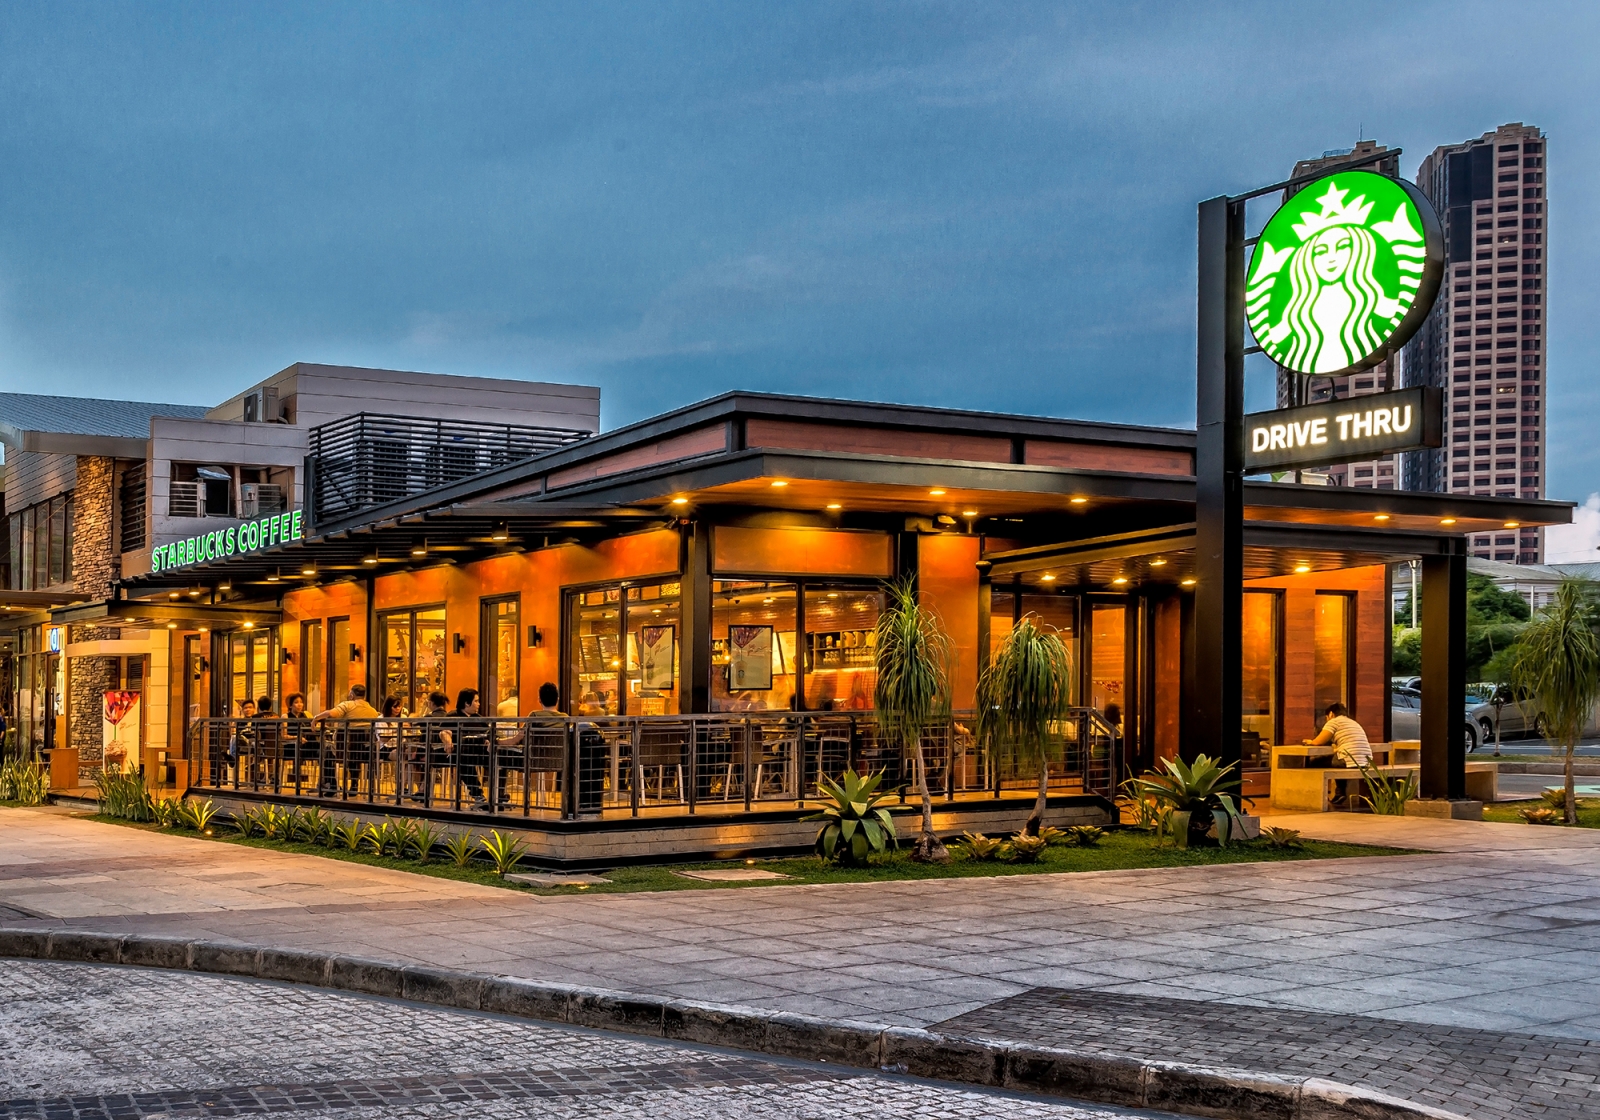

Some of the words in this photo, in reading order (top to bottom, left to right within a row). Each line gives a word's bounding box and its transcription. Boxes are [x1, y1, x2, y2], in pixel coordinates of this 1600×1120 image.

[1252, 417, 1328, 453] DRIVE
[1335, 404, 1412, 441] THRU
[151, 527, 235, 573] STARBUCKS
[237, 509, 303, 553] COFFEE
